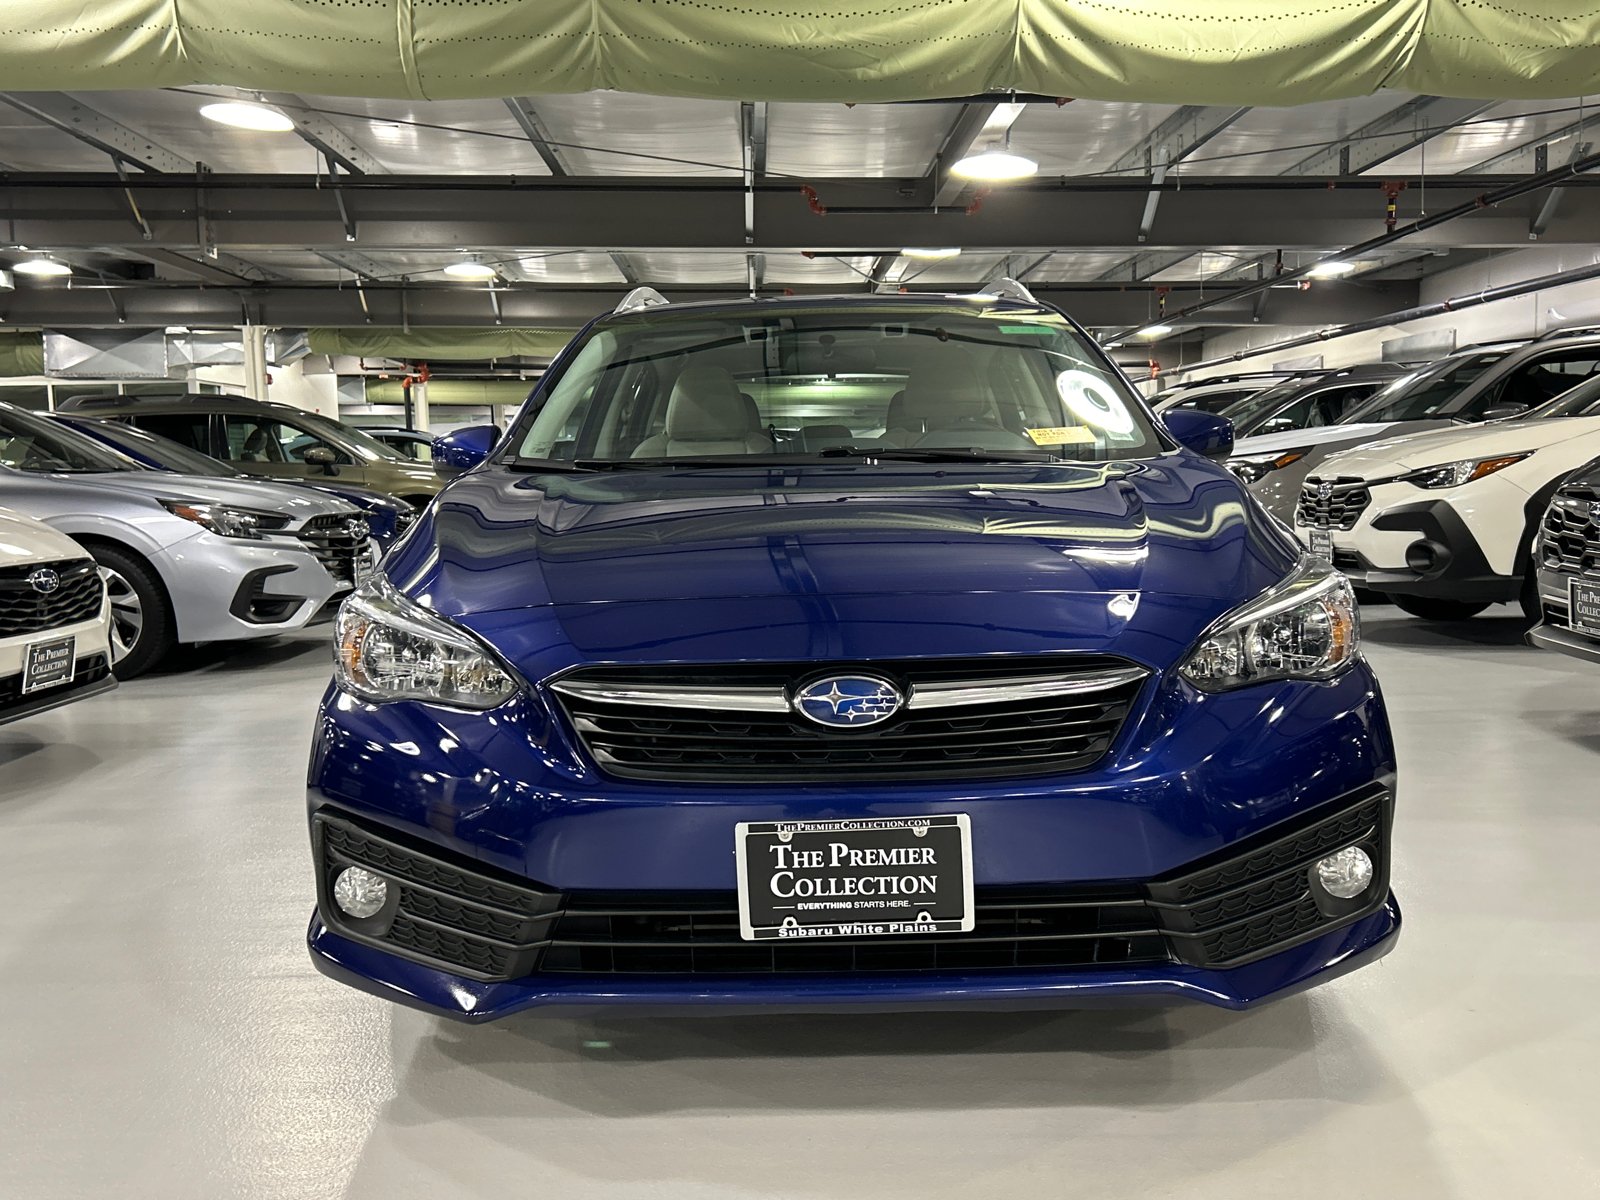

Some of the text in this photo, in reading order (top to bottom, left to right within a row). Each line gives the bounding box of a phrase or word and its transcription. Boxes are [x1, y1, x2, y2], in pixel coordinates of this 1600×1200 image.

[1576, 589, 1588, 602] THE
[33, 648, 69, 663] THE PREMIER
[31, 659, 68, 675] COLLECTION
[769, 843, 937, 869] THE PREMIER
[770, 871, 938, 898] COLLECTION
[797, 900, 911, 910] EVERYTHING STARTS HERE.
[778, 922, 937, 937] Subaru White Plains
